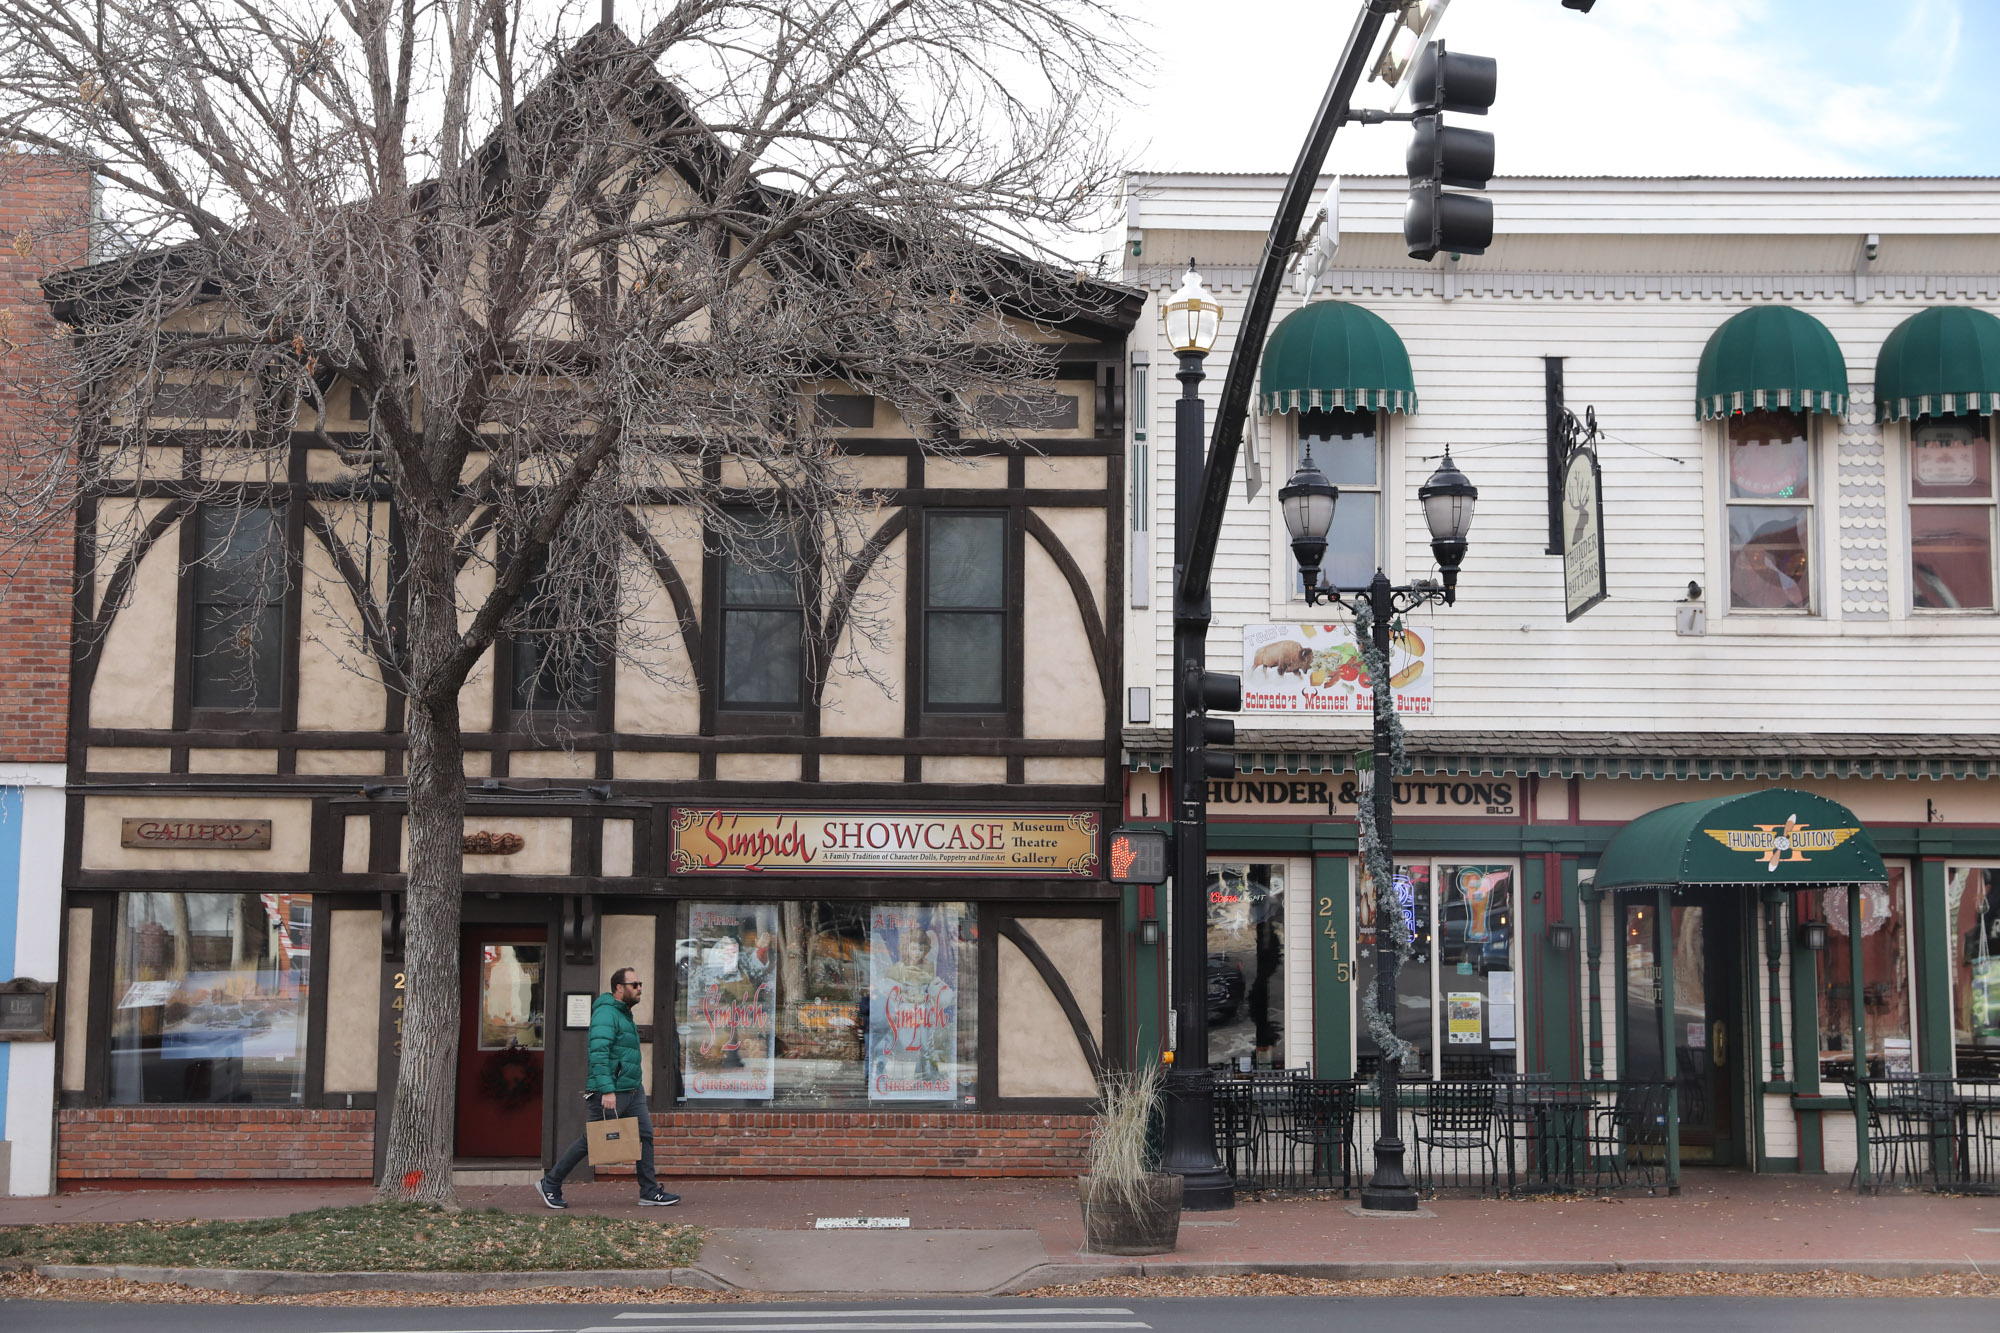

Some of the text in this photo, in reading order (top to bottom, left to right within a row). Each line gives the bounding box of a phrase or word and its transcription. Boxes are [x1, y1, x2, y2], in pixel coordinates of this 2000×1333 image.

[1566, 533, 1598, 570] THUNDER
[1568, 562, 1599, 598] BUTTONS
[1245, 692, 1297, 710] Colorado's
[1304, 692, 1349, 711] Meanest
[1397, 694, 1432, 714] Burger
[1206, 781, 1513, 805] HUNDER & UTTONS
[1486, 806, 1514, 815] BLD
[137, 822, 262, 843] GALLERY
[1012, 821, 1065, 832] Museum
[704, 810, 1005, 872] Simpich SHOWCASE
[1011, 836, 1058, 848] Theatre
[1727, 831, 1773, 849] THUNDER
[1791, 830, 1836, 848] BUTTONS
[823, 852, 828, 860] A
[829, 852, 850, 862] Family
[852, 853, 879, 861] Tradition
[879, 853, 889, 861] of
[889, 853, 919, 861] Character
[920, 853, 938, 862] Dolls,
[939, 854, 967, 862] Puppetry
[1011, 852, 1058, 866] Gallery
[692, 911, 704, 927] A
[873, 914, 886, 929] A
[700, 983, 767, 1054] Simpich
[883, 985, 950, 1056] Simpich
[692, 1072, 767, 1094] CHRISTMAS
[876, 1074, 950, 1095] CHRISTMAS
